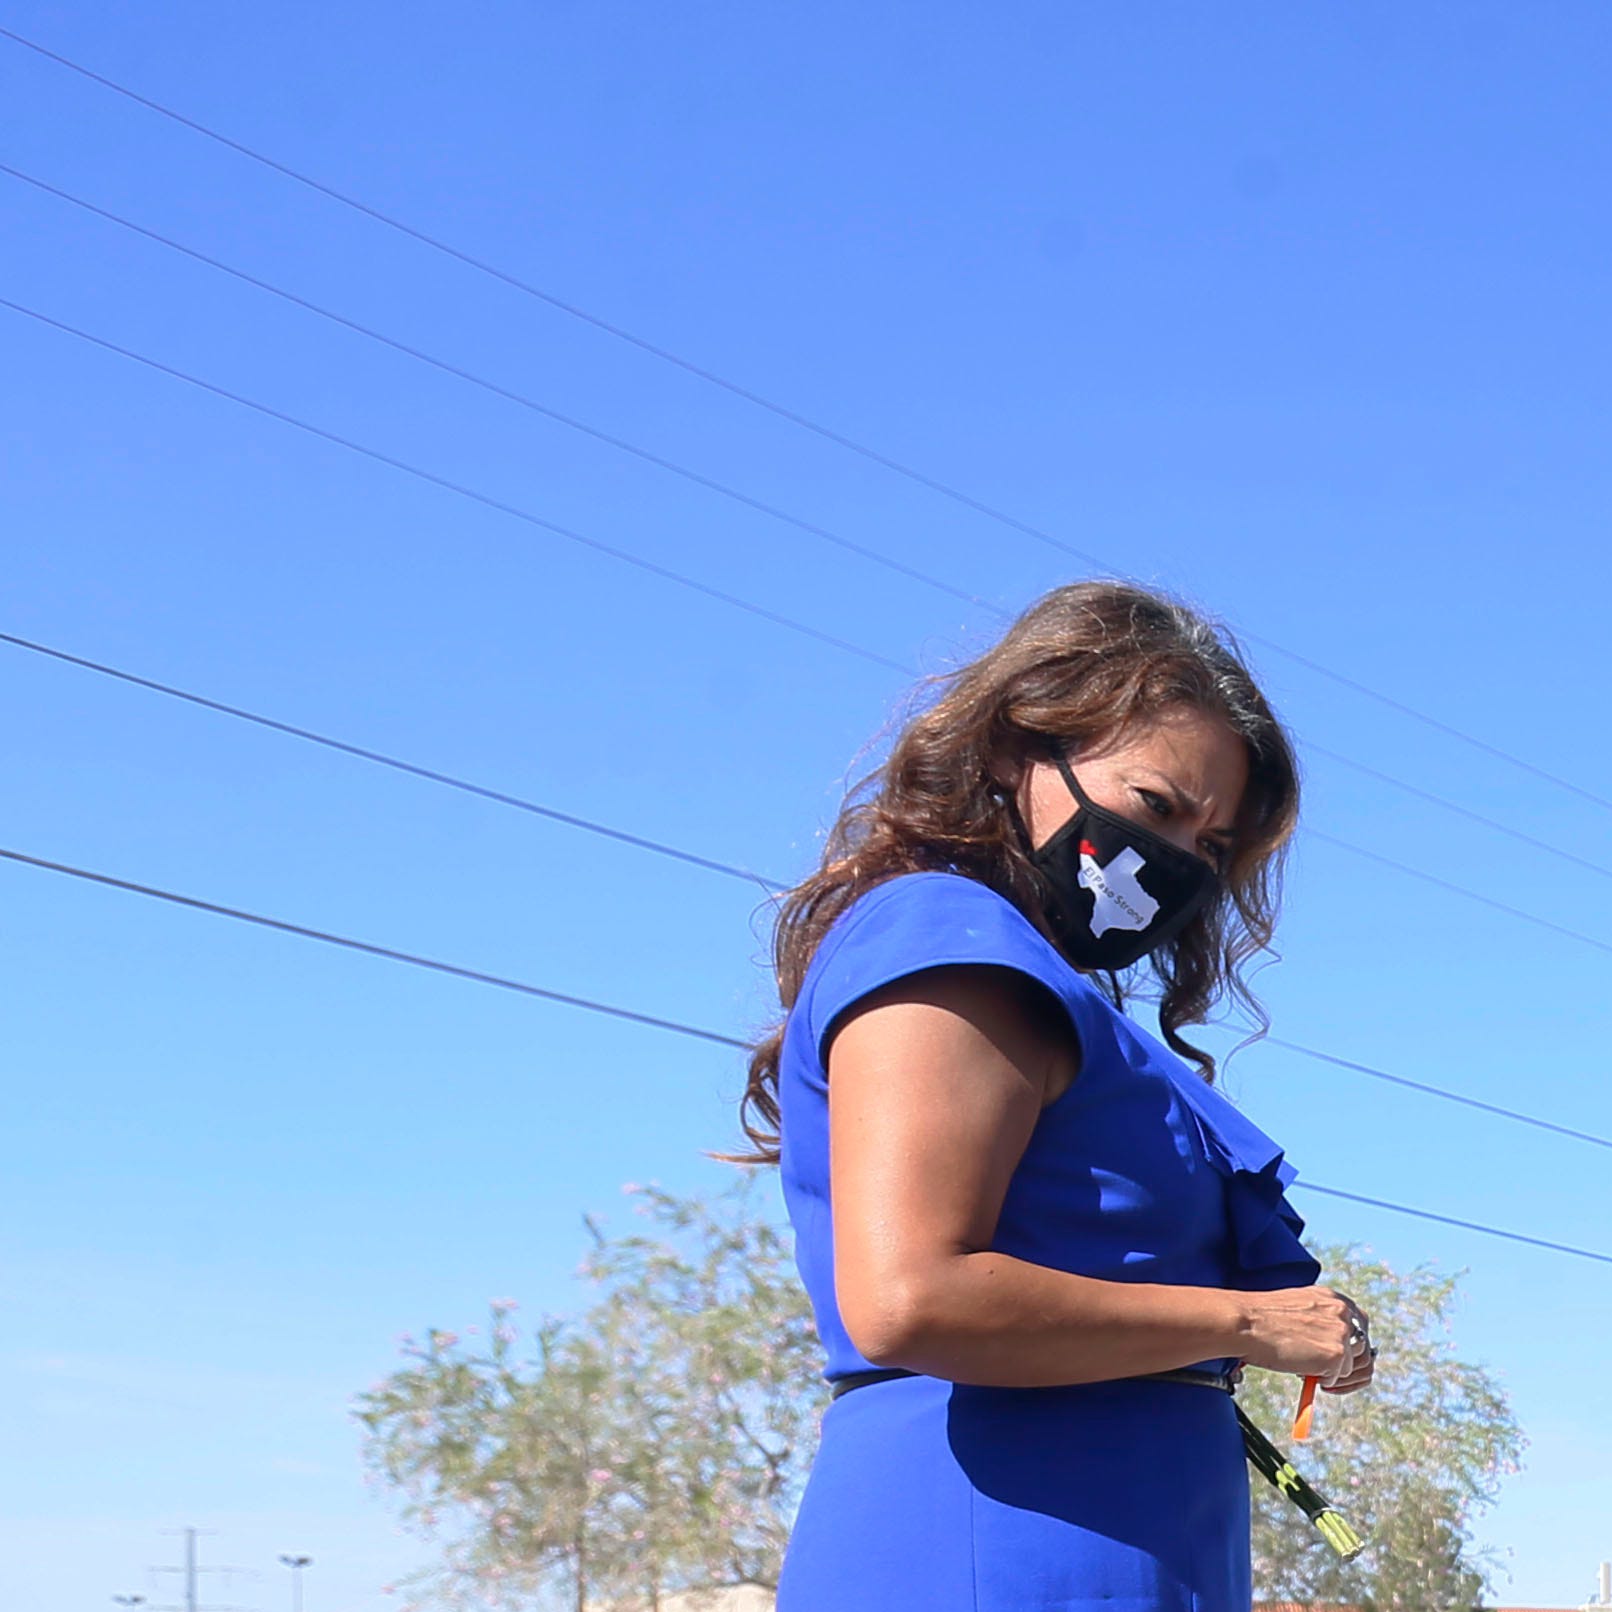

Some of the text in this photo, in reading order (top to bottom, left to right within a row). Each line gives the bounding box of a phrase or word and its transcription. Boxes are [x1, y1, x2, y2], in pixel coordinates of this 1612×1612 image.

[1083, 866, 1145, 925] El Paso Strong
